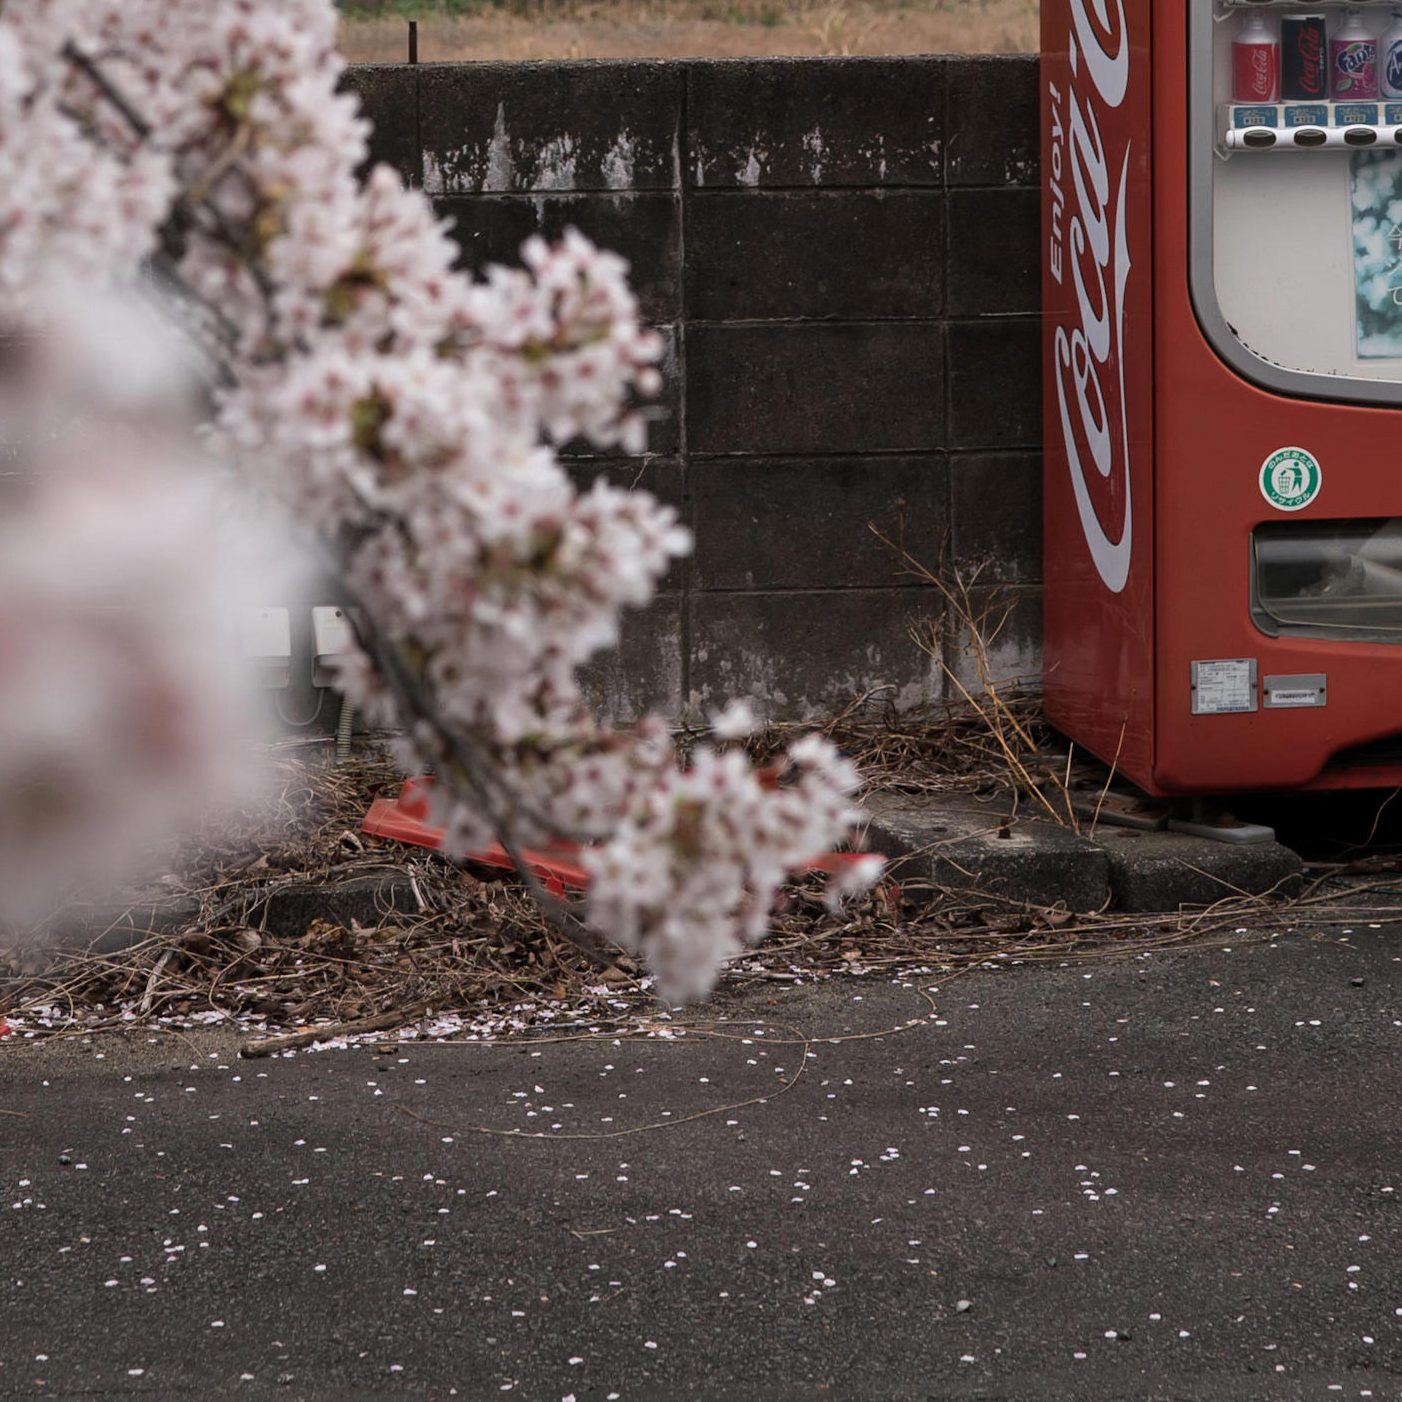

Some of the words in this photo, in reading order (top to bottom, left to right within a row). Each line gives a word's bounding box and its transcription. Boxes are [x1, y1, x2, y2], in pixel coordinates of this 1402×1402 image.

[1252, 48, 1267, 95] Coca-Cola
[1049, 79, 1063, 286] Enjoy!
[1270, 491, 1310, 506] リサイクル
